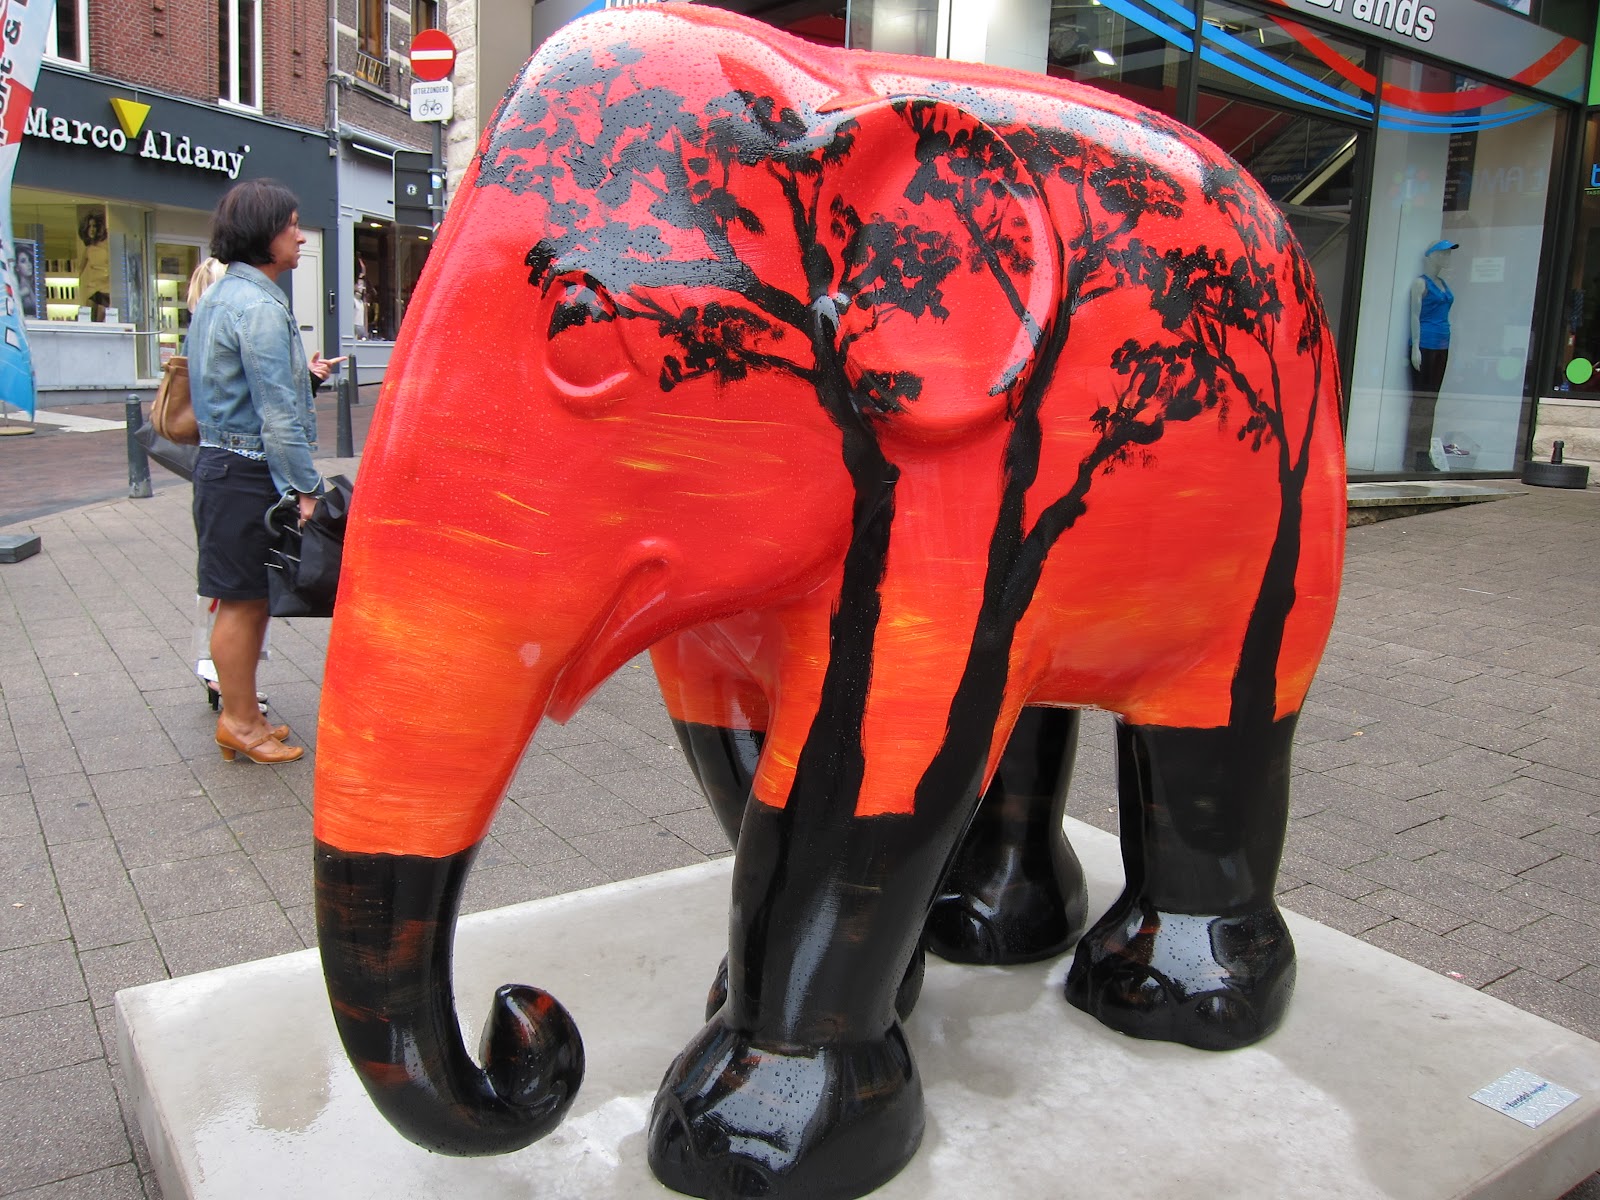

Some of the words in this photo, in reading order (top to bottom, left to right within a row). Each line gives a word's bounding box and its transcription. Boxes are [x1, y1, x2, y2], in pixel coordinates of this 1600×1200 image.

[1305, 0, 1436, 42] rands
[413, 85, 449, 95] UITGEZONDERD
[23, 107, 127, 152] Marco
[140, 129, 245, 180] Aldany
